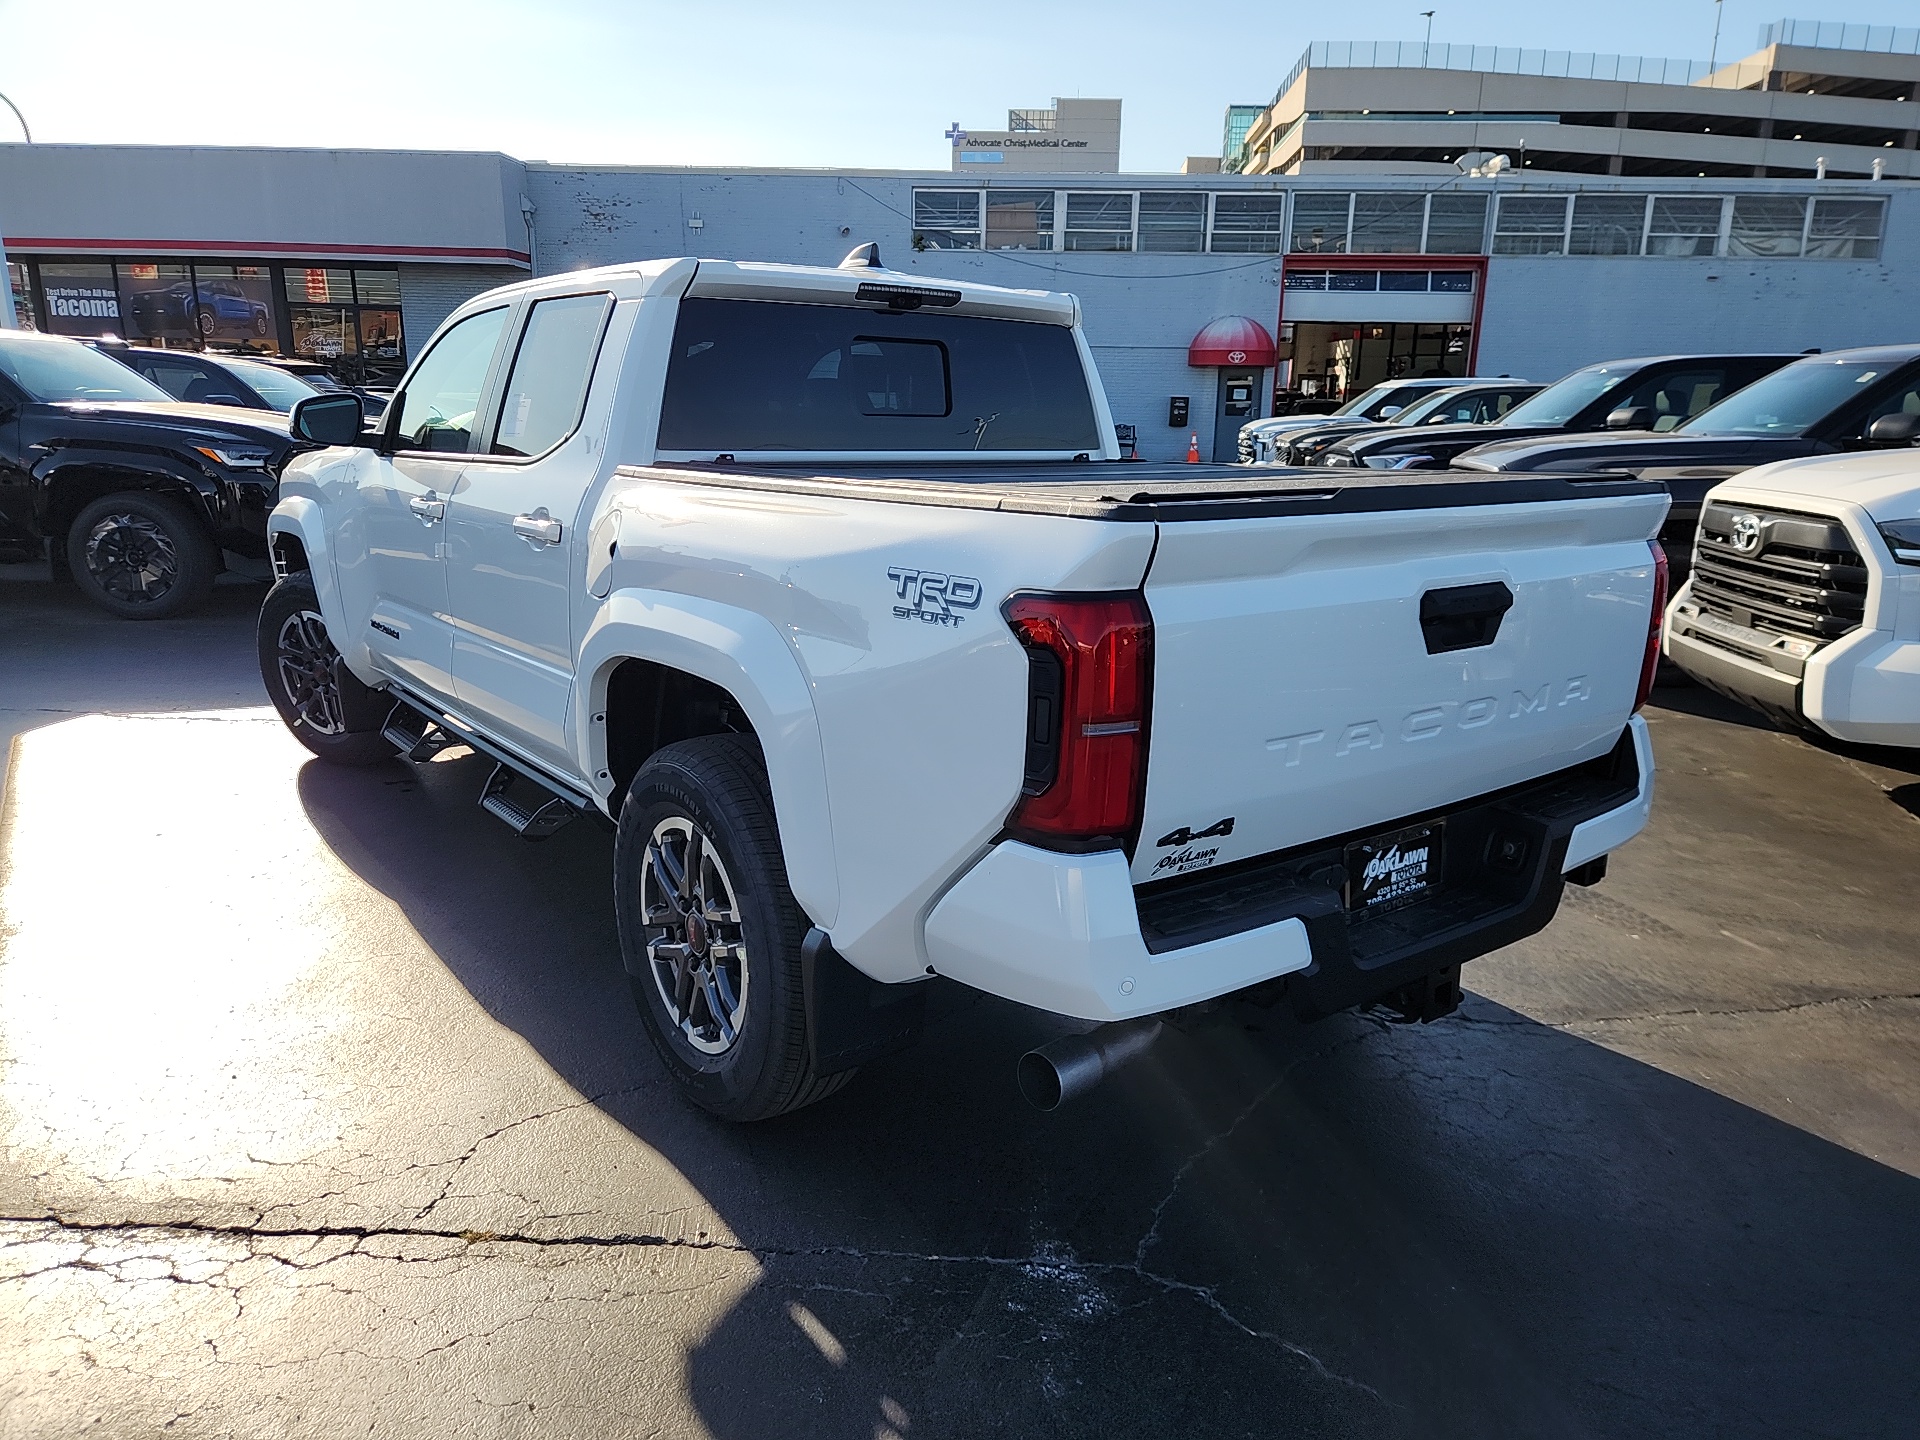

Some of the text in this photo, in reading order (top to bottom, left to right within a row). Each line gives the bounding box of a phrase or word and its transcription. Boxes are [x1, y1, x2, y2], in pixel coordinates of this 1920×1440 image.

[966, 138, 1088, 148] Advocate Christ Medical Center
[45, 287, 60, 296] Test
[60, 288, 78, 297] Drive
[78, 288, 91, 297] The
[46, 295, 119, 317] Tacoma
[887, 566, 983, 612] TRD
[892, 605, 965, 628] SPORT
[1265, 674, 1591, 768] TACOMA
[1367, 847, 1429, 878] OAKLAWN
[1391, 883, 1398, 891] W
